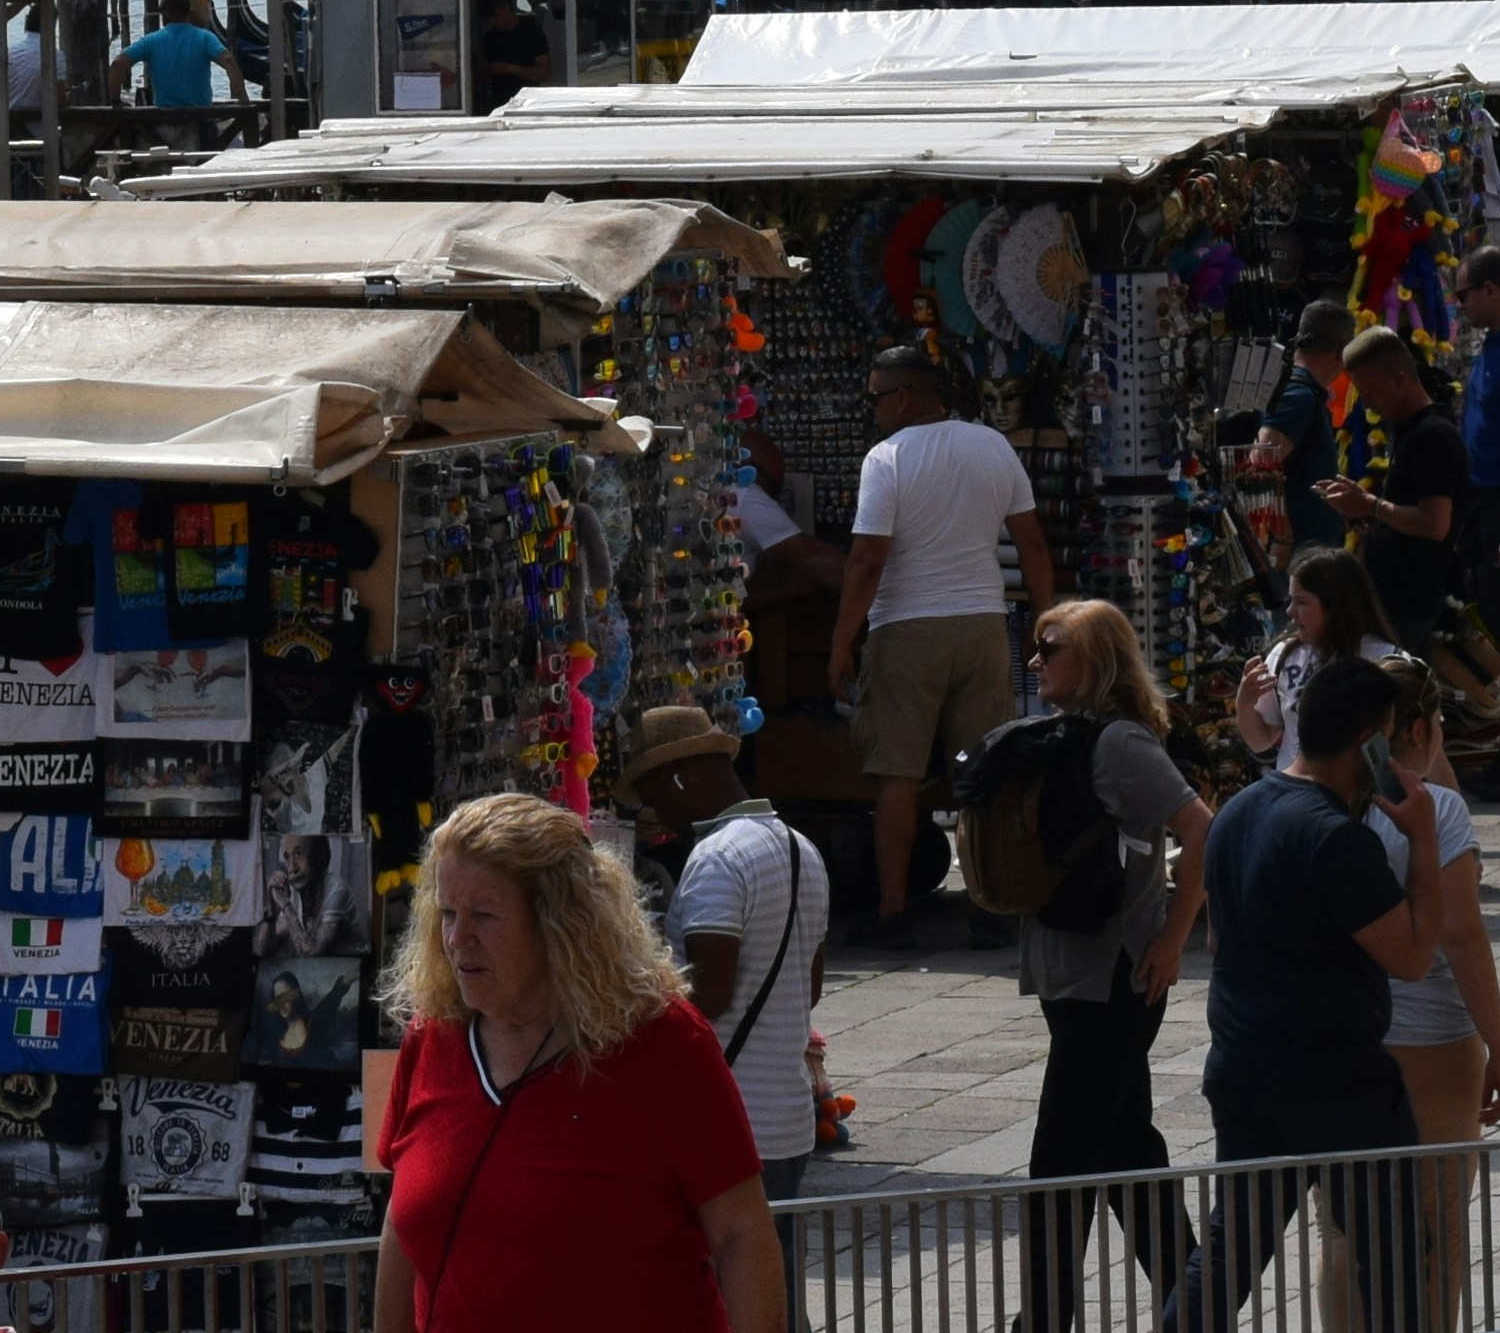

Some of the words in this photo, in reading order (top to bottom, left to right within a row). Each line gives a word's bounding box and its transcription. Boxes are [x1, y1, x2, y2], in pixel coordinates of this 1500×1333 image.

[268, 540, 340, 558] ENEZIA
[176, 585, 247, 607] Venezia
[12, 947, 62, 960] VENEZIA
[150, 970, 211, 988] ITALIA
[16, 1037, 59, 1050] VENEZIA
[110, 1020, 228, 1054] VENEZIA
[125, 1077, 237, 1121] Venezia
[127, 1135, 146, 1156] 18
[211, 1140, 231, 1163] 68
[10, 1232, 90, 1264] ENEZIA
